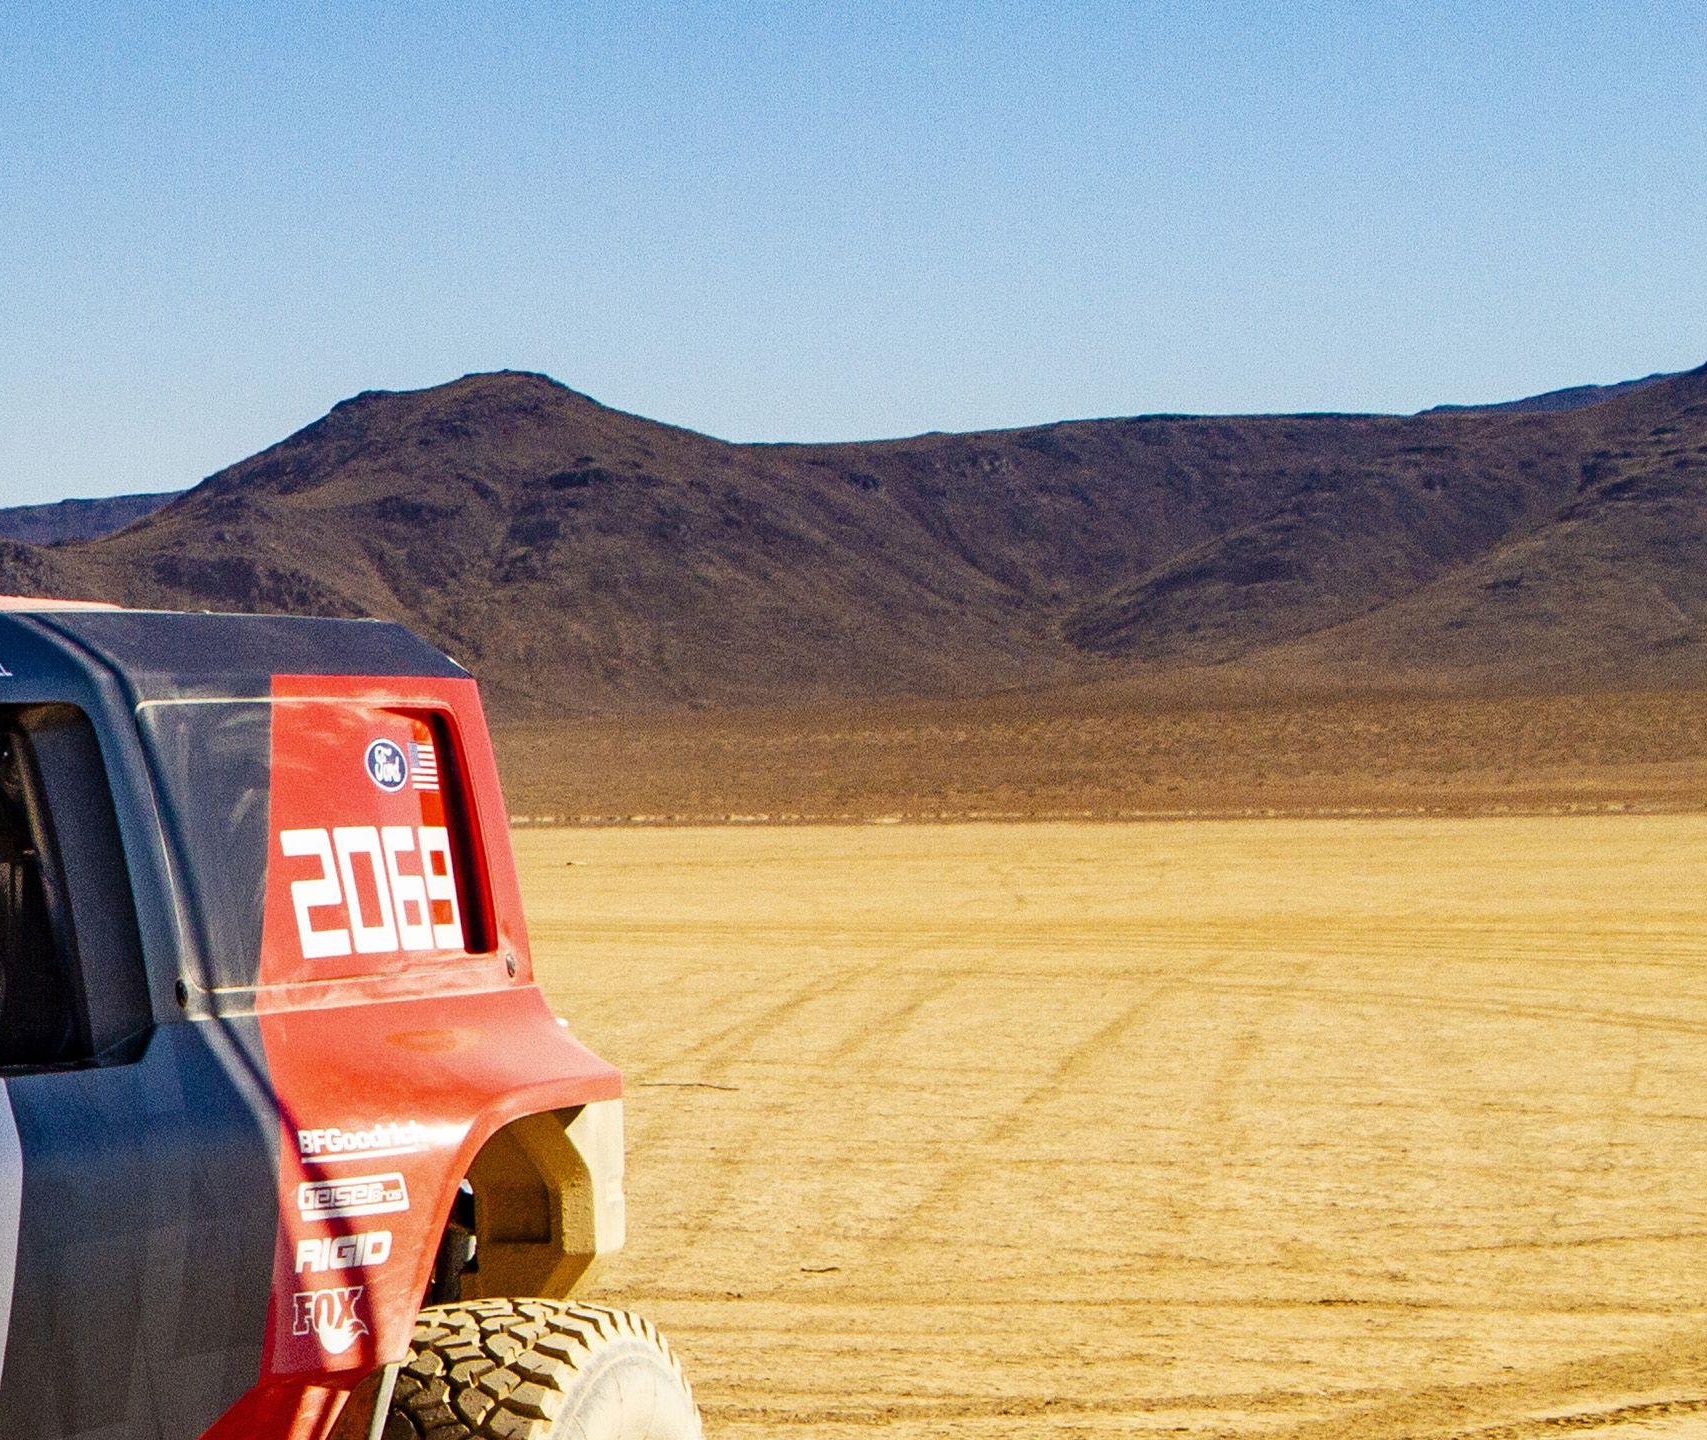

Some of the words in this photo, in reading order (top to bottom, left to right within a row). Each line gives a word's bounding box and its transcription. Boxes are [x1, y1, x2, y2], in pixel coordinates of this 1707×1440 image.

[280, 826, 465, 959] 2069
[298, 1120, 427, 1154] BFGoodrich
[294, 1231, 393, 1275] RIGID
[293, 1286, 366, 1337] FOX
